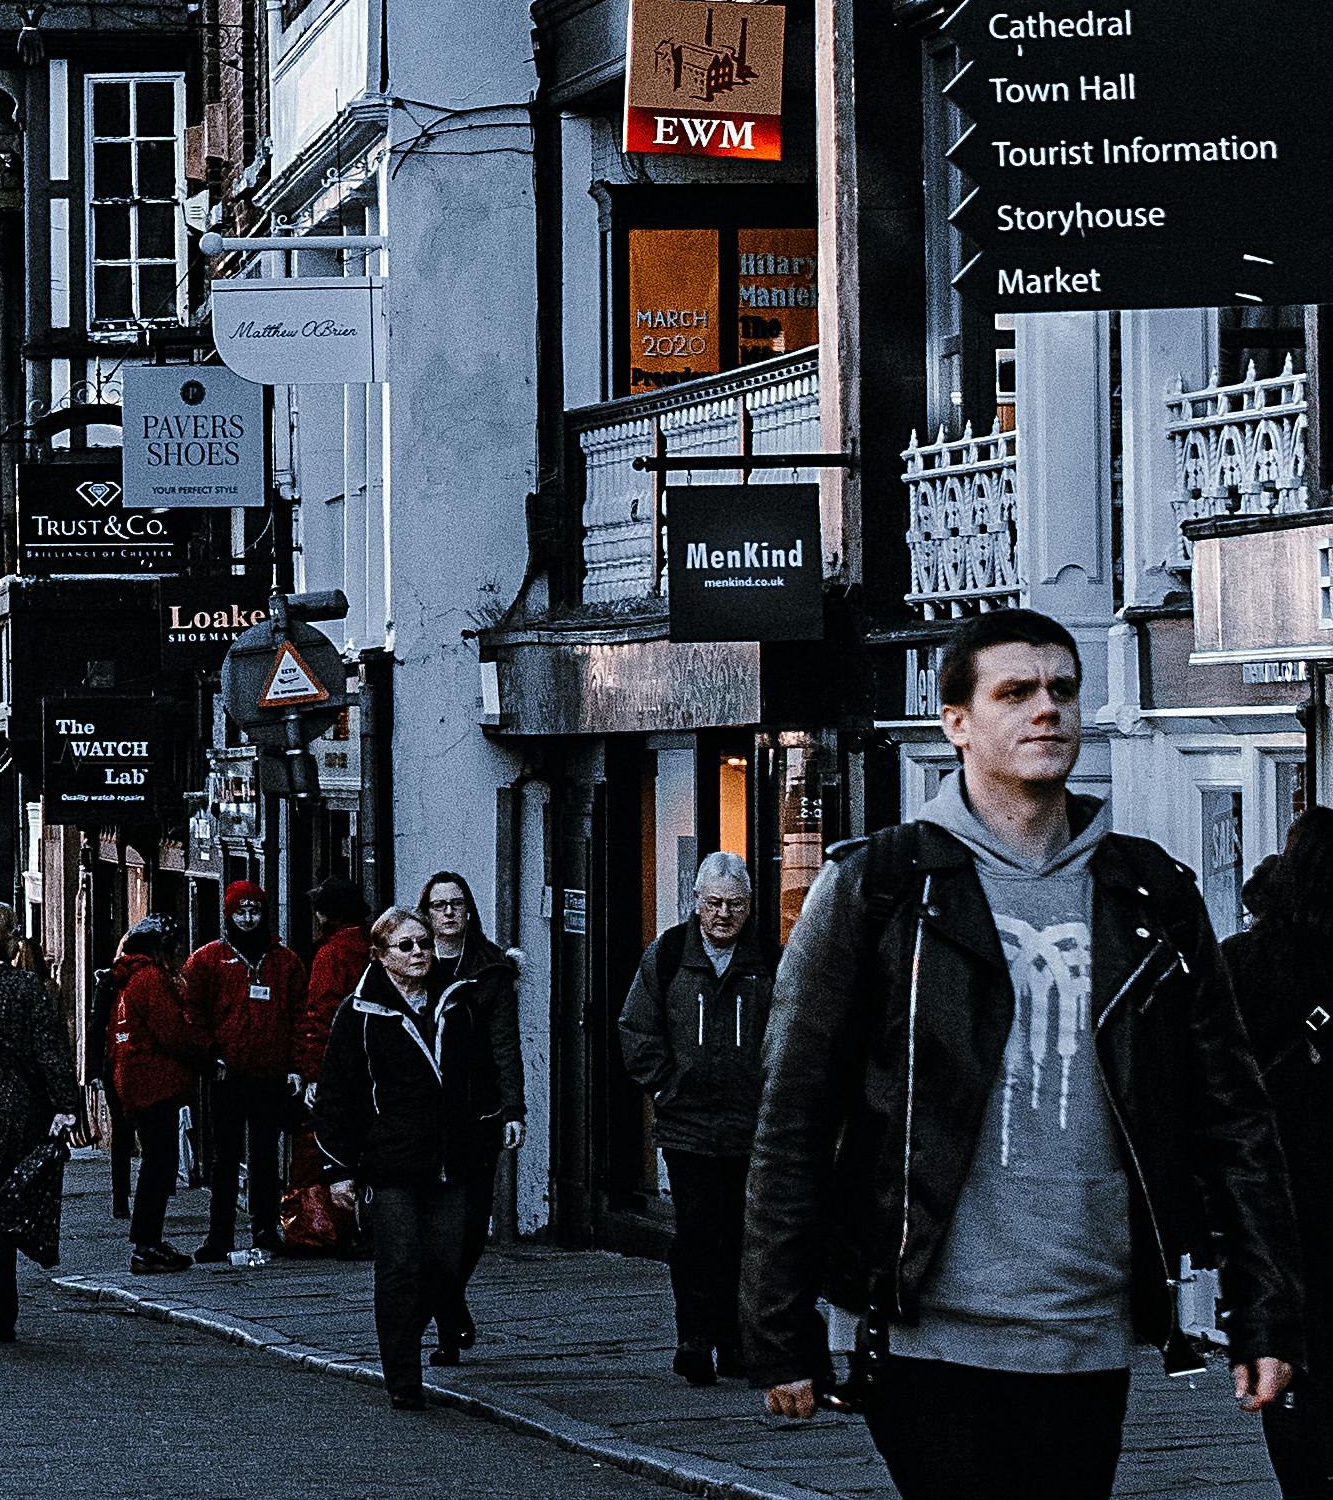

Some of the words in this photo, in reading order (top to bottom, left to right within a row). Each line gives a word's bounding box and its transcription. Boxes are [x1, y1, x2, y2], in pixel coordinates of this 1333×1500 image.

[989, 9, 1132, 39] Cathedral
[989, 77, 1069, 103] Town
[1080, 73, 1135, 100] Hall
[653, 116, 755, 150] EWM
[992, 140, 1093, 167] Tourist
[1104, 136, 1278, 164] Information
[997, 202, 1166, 236] Storyhouse
[740, 252, 817, 279] Hilary
[998, 267, 1101, 295] Market
[740, 284, 818, 308] Mantel
[229, 321, 298, 339] Matthew
[636, 309, 709, 328] MARCH
[642, 335, 706, 356] 2020
[143, 415, 244, 439] PAVERS
[148, 442, 239, 466] SHOES
[152, 486, 176, 494] YOUR
[179, 486, 212, 494] PERFECT
[215, 486, 238, 494] STYLE
[686, 540, 802, 569] MenKind
[705, 577, 784, 588] menkind.co.uk
[169, 604, 266, 629] Loake
[56, 720, 95, 734] The
[71, 742, 148, 756] WATCH
